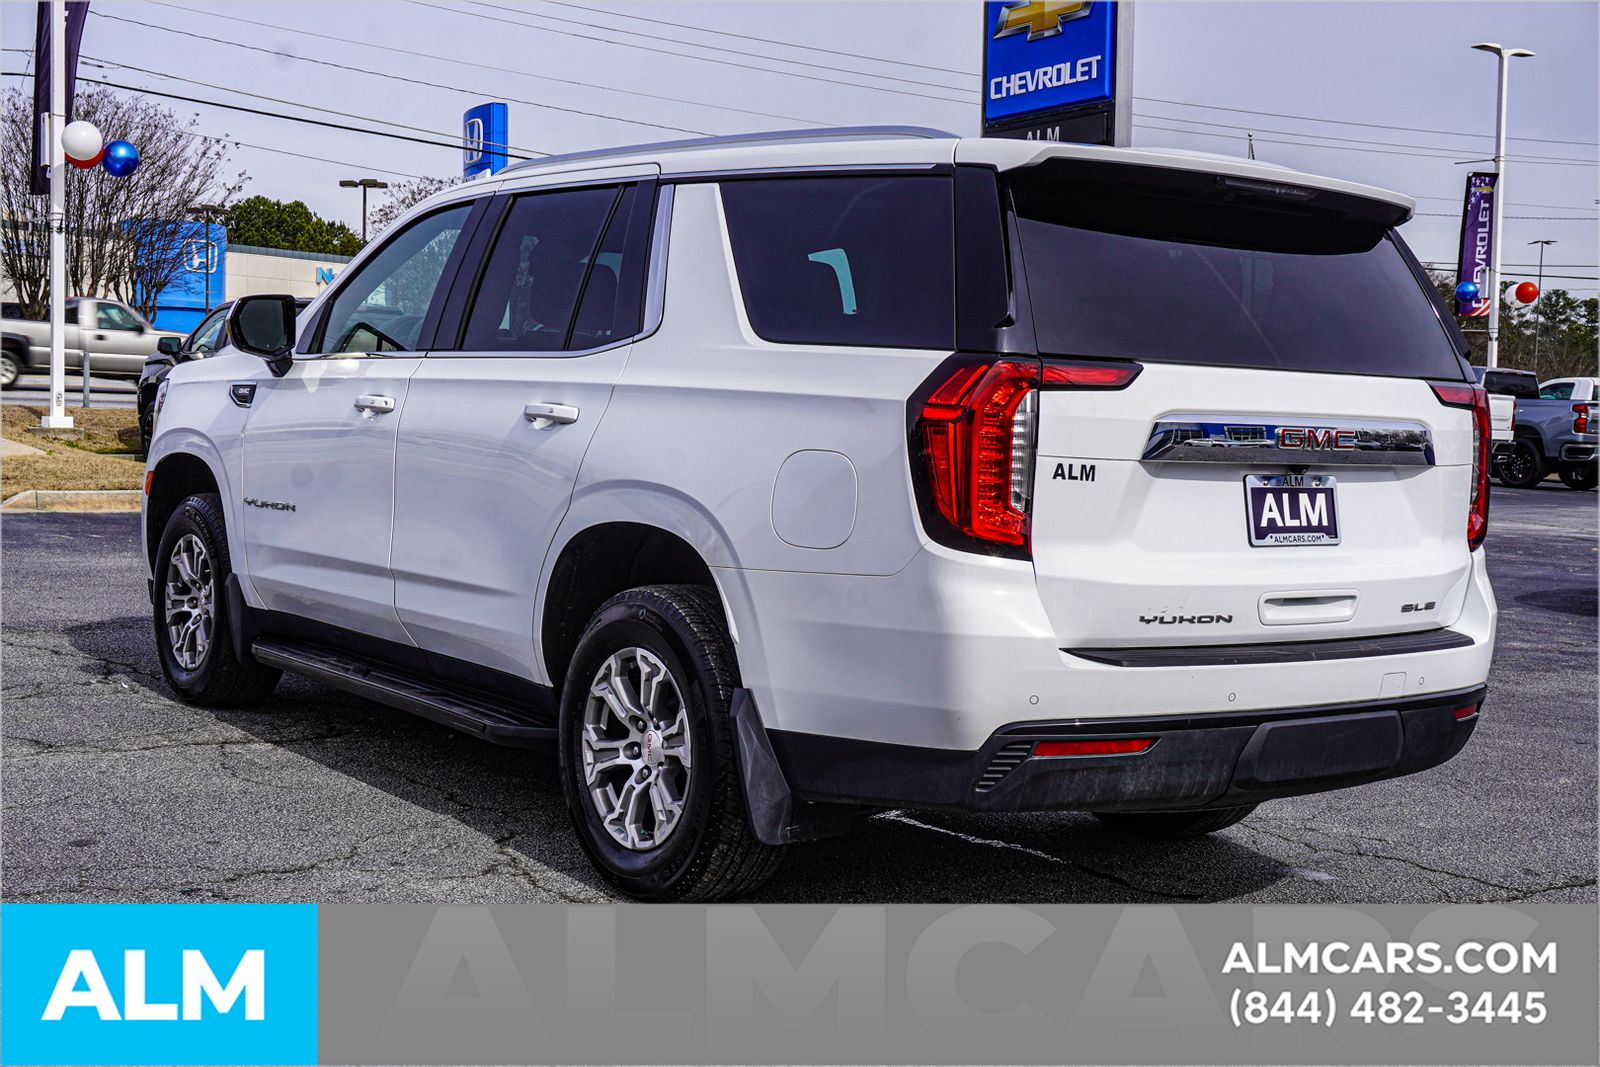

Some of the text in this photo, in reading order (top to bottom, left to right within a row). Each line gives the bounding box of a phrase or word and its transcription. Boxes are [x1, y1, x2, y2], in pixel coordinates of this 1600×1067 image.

[990, 55, 1101, 100] CHEVROLET
[1472, 200, 1490, 308] CEVROLET
[1275, 427, 1356, 451] GMC
[1052, 462, 1096, 482] ALM
[1282, 475, 1304, 487] ALM
[243, 496, 296, 512] YUKON
[1260, 492, 1329, 527] ALM
[1274, 534, 1322, 543] ALMCARS.COM
[1400, 601, 1437, 613] SLE
[1138, 614, 1233, 625] YUKON
